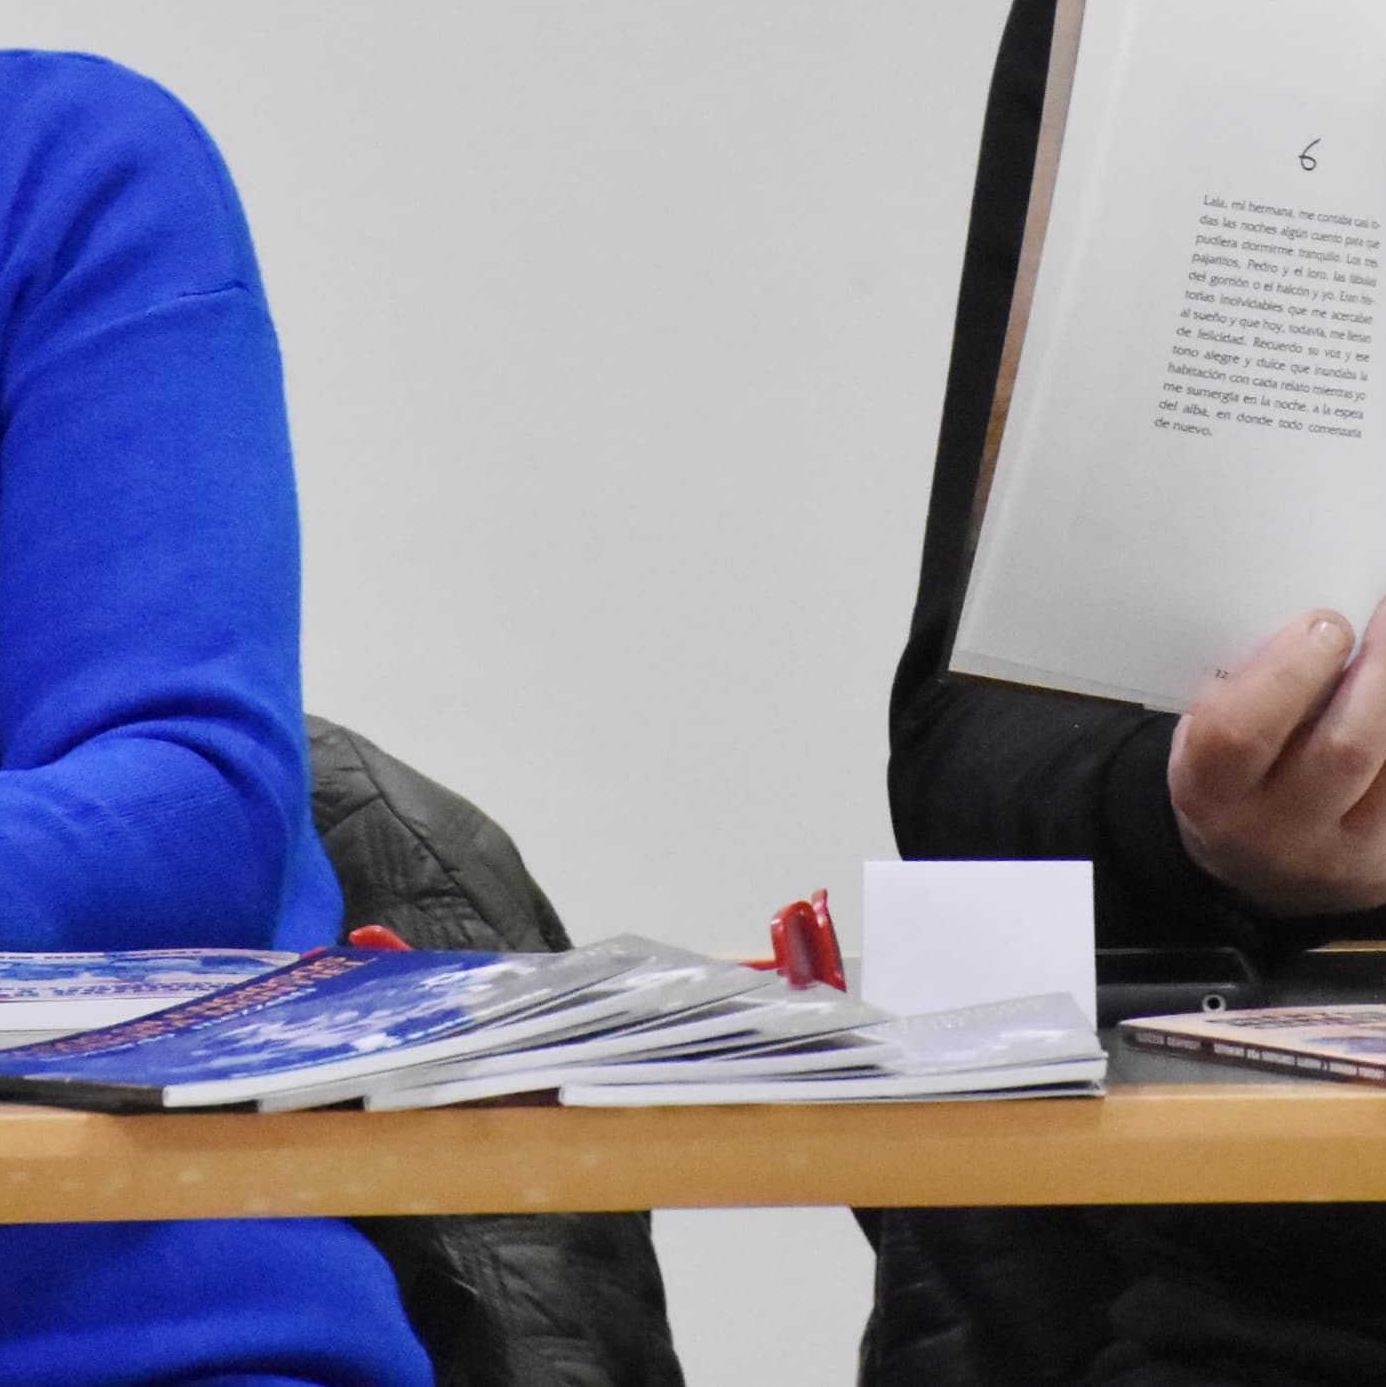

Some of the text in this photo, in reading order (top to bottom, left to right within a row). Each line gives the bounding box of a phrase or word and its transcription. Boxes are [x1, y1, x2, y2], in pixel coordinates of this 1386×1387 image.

[1298, 138, 1321, 171] 6
[1199, 212, 1218, 226] das
[1222, 215, 1236, 228] las
[1240, 220, 1277, 234] noches
[1247, 257, 1277, 273] Pedro
[1293, 264, 1302, 276] el
[1189, 267, 1205, 281] del
[1263, 279, 1273, 291] el
[1193, 310, 1226, 323] sueño
[1239, 317, 1259, 329] que
[1287, 304, 1307, 317] que
[1312, 307, 1326, 317] me
[1176, 323, 1191, 337] de
[1252, 334, 1302, 352] Recuerdo
[1172, 343, 1198, 357] tono
[1203, 347, 1239, 365] alegre
[1290, 362, 1309, 374] que
[1168, 361, 1226, 380] habitación
[1229, 373, 1249, 384] con
[1163, 382, 1181, 393] me
[1242, 393, 1257, 404] en
[1260, 392, 1270, 405] la
[1154, 414, 1170, 428] de
[1159, 396, 1177, 411] del
[1216, 408, 1231, 419] en
[1236, 408, 1273, 425] donde
[1278, 415, 1302, 429] todo
